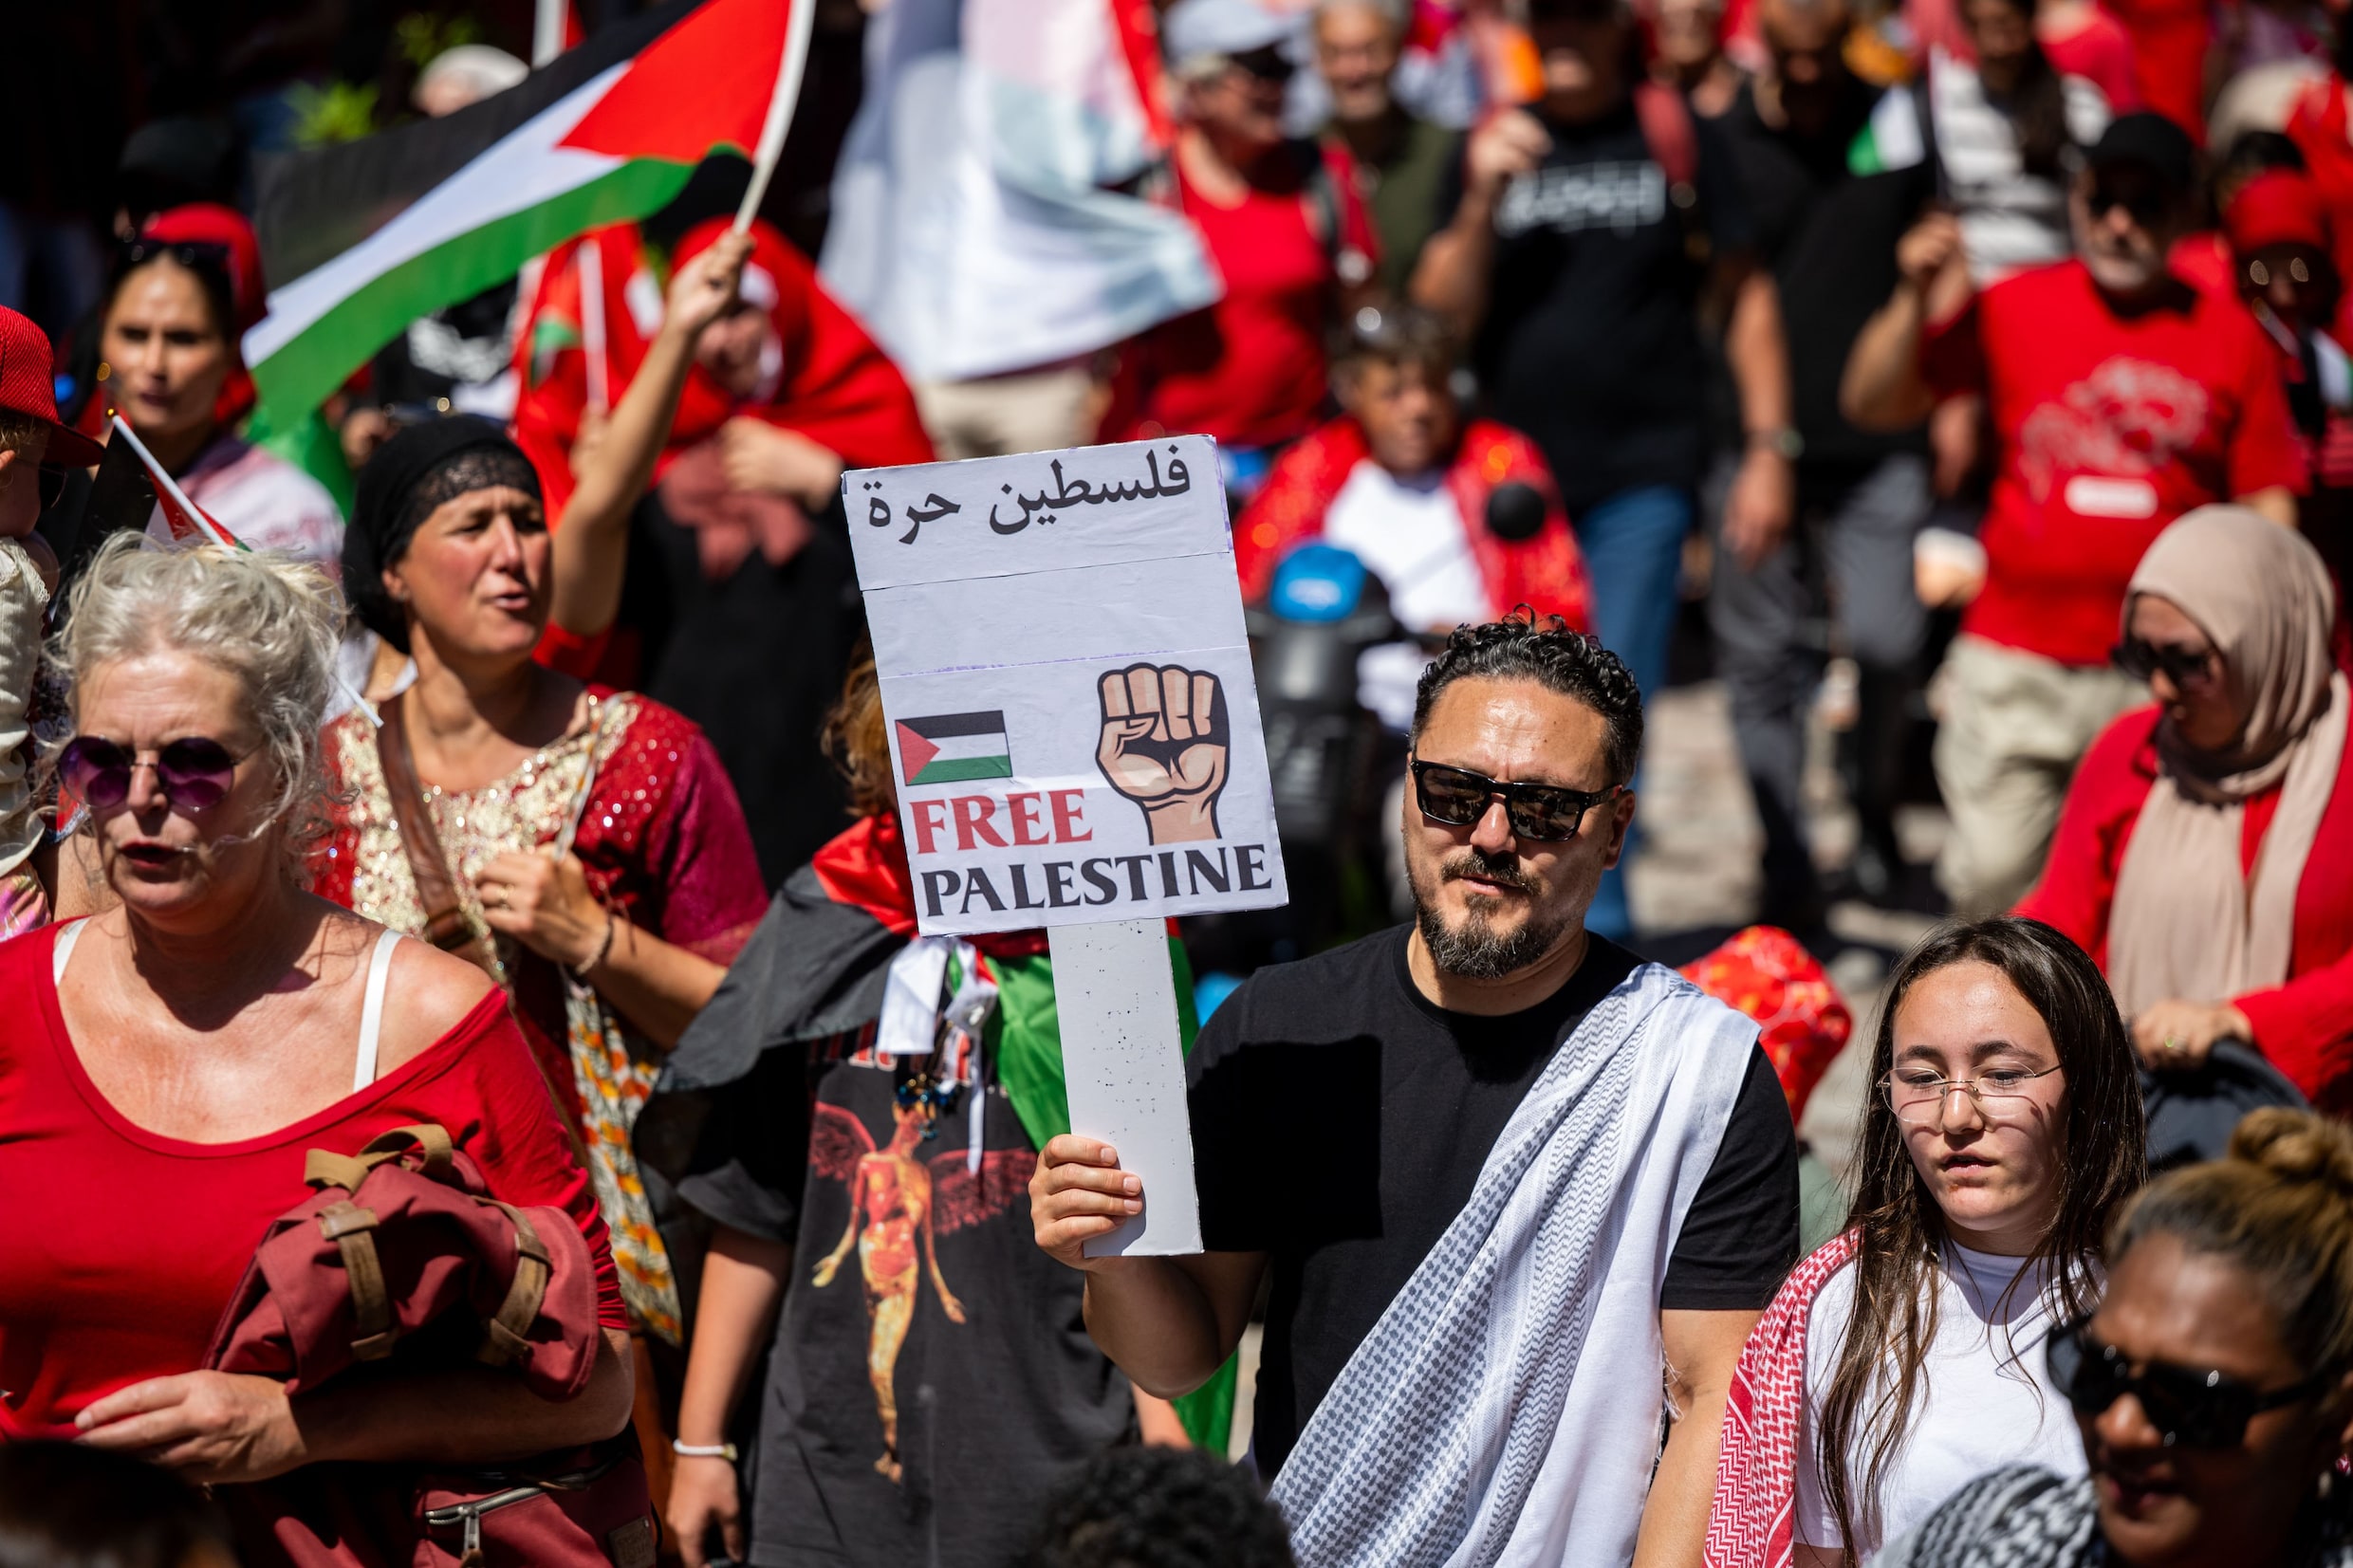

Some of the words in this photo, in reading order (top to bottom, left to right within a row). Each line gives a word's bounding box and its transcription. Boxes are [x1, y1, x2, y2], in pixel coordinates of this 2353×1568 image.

[862, 480, 962, 545] حرة
[989, 444, 1191, 535] فلسطين
[909, 788, 1093, 855] FREE
[920, 843, 1272, 917] PALESTINE
